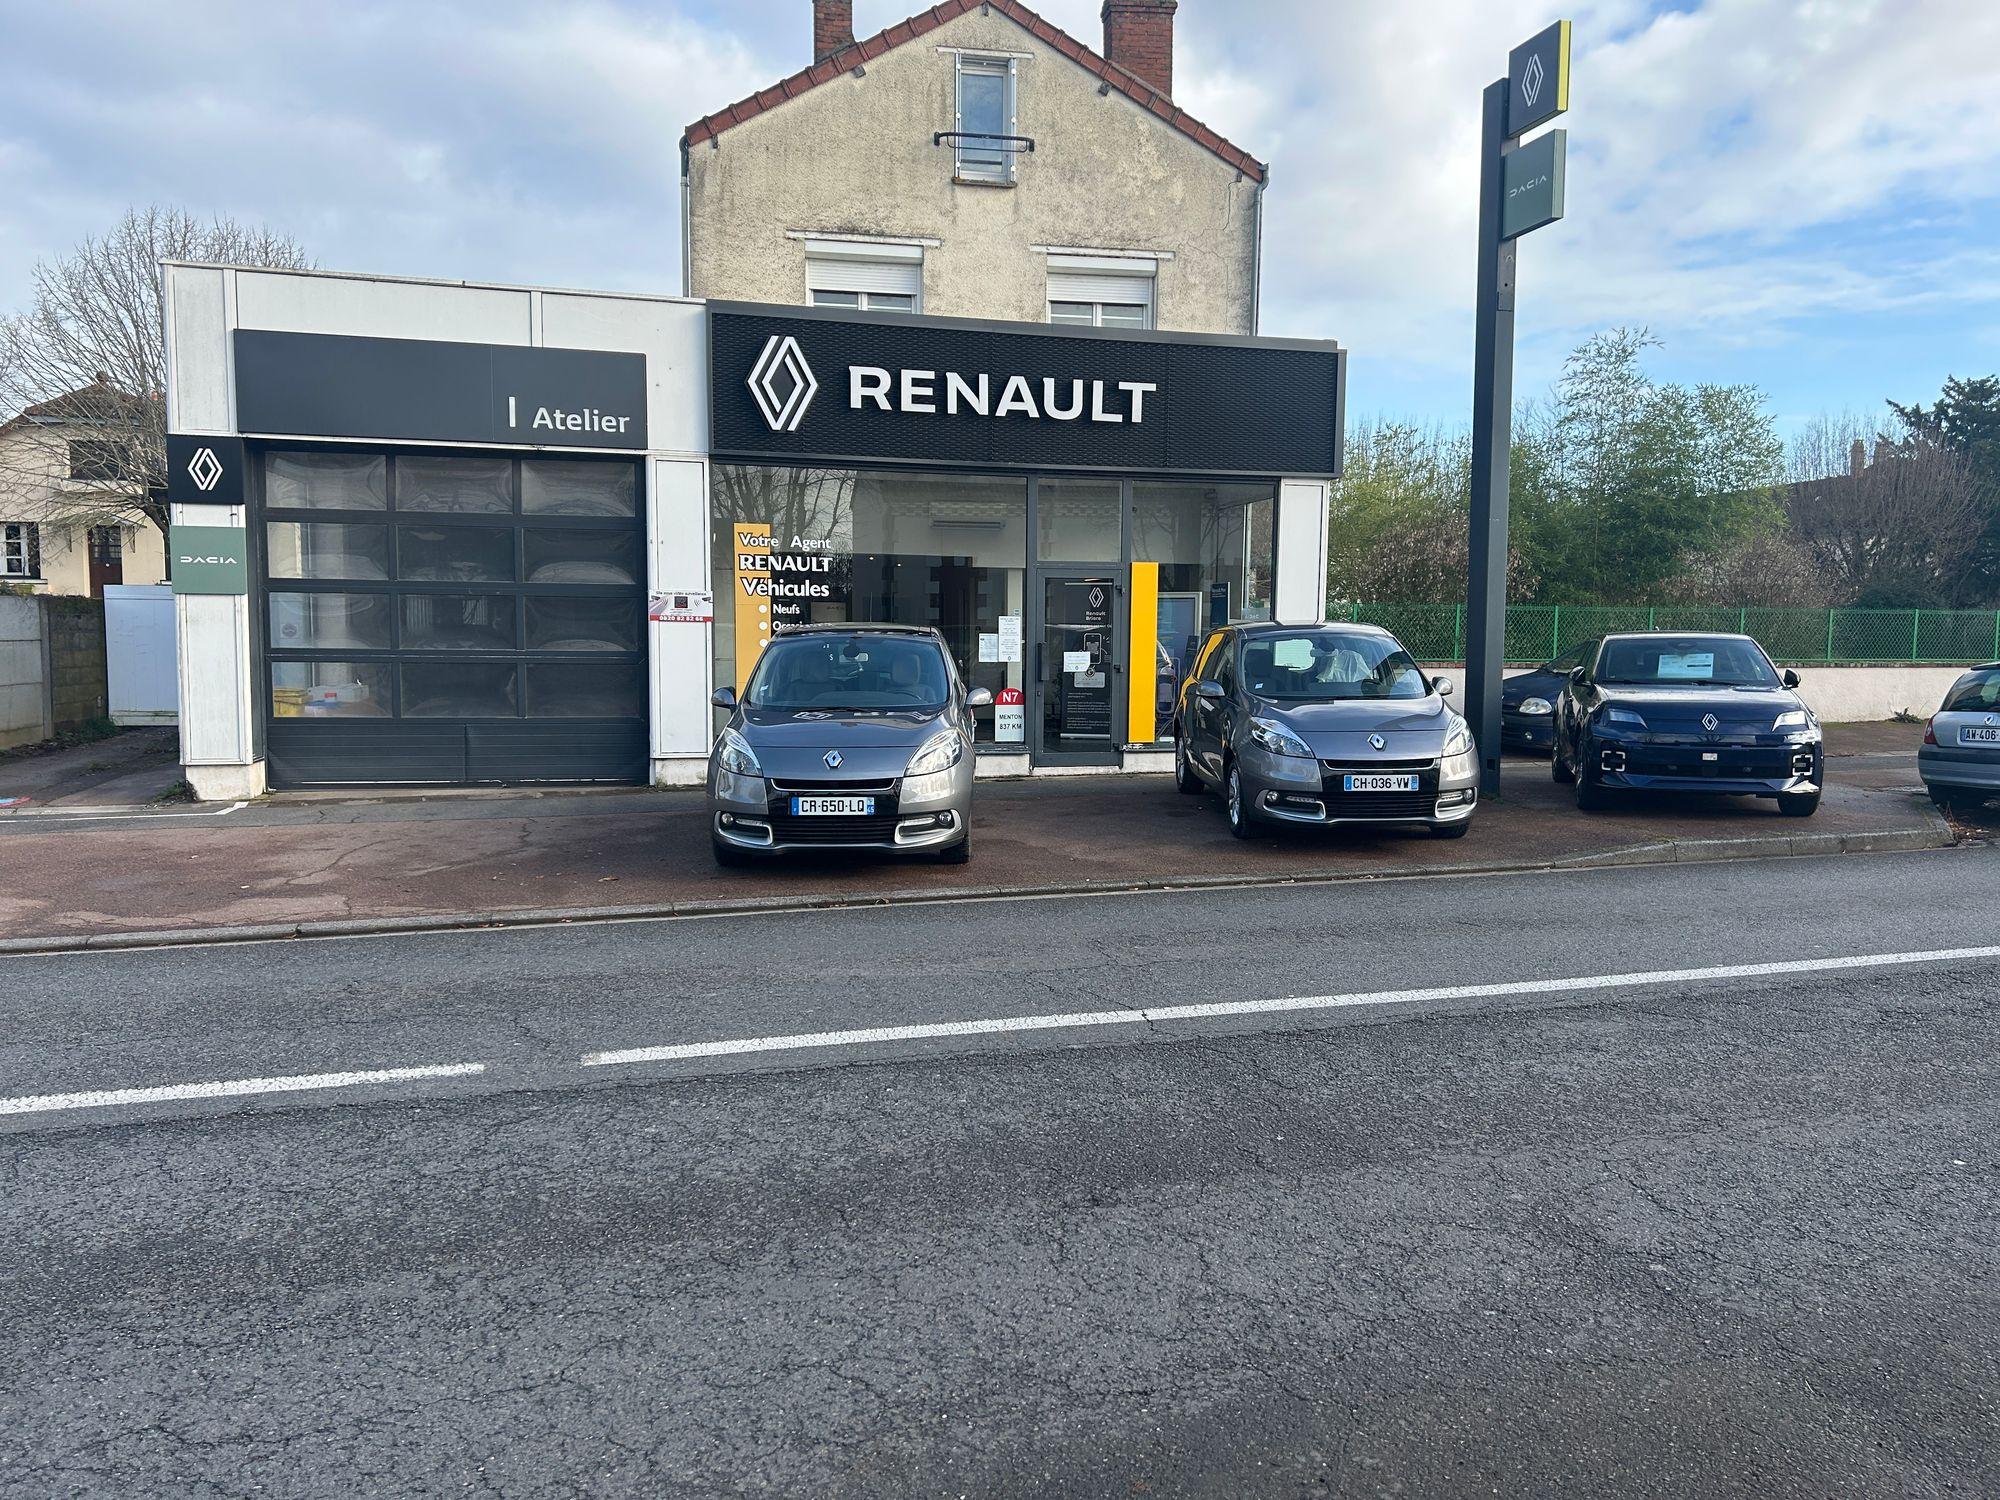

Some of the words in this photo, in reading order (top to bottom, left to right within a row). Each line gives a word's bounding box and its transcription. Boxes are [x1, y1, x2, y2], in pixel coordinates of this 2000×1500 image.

[1509, 175, 1547, 198] DACIA
[848, 365, 1157, 424] RENAULT
[532, 407, 630, 433] Atelier
[739, 532, 779, 547] Votre
[791, 535, 831, 552] Agent
[180, 555, 238, 564] DACIA
[739, 554, 833, 572] RENAULT
[741, 577, 830, 597] Véhicules
[773, 604, 800, 615] Neufs
[1002, 692, 1019, 703] N7
[1353, 777, 1410, 789] CH-036-VW
[801, 800, 865, 813] CR-650-LQ
